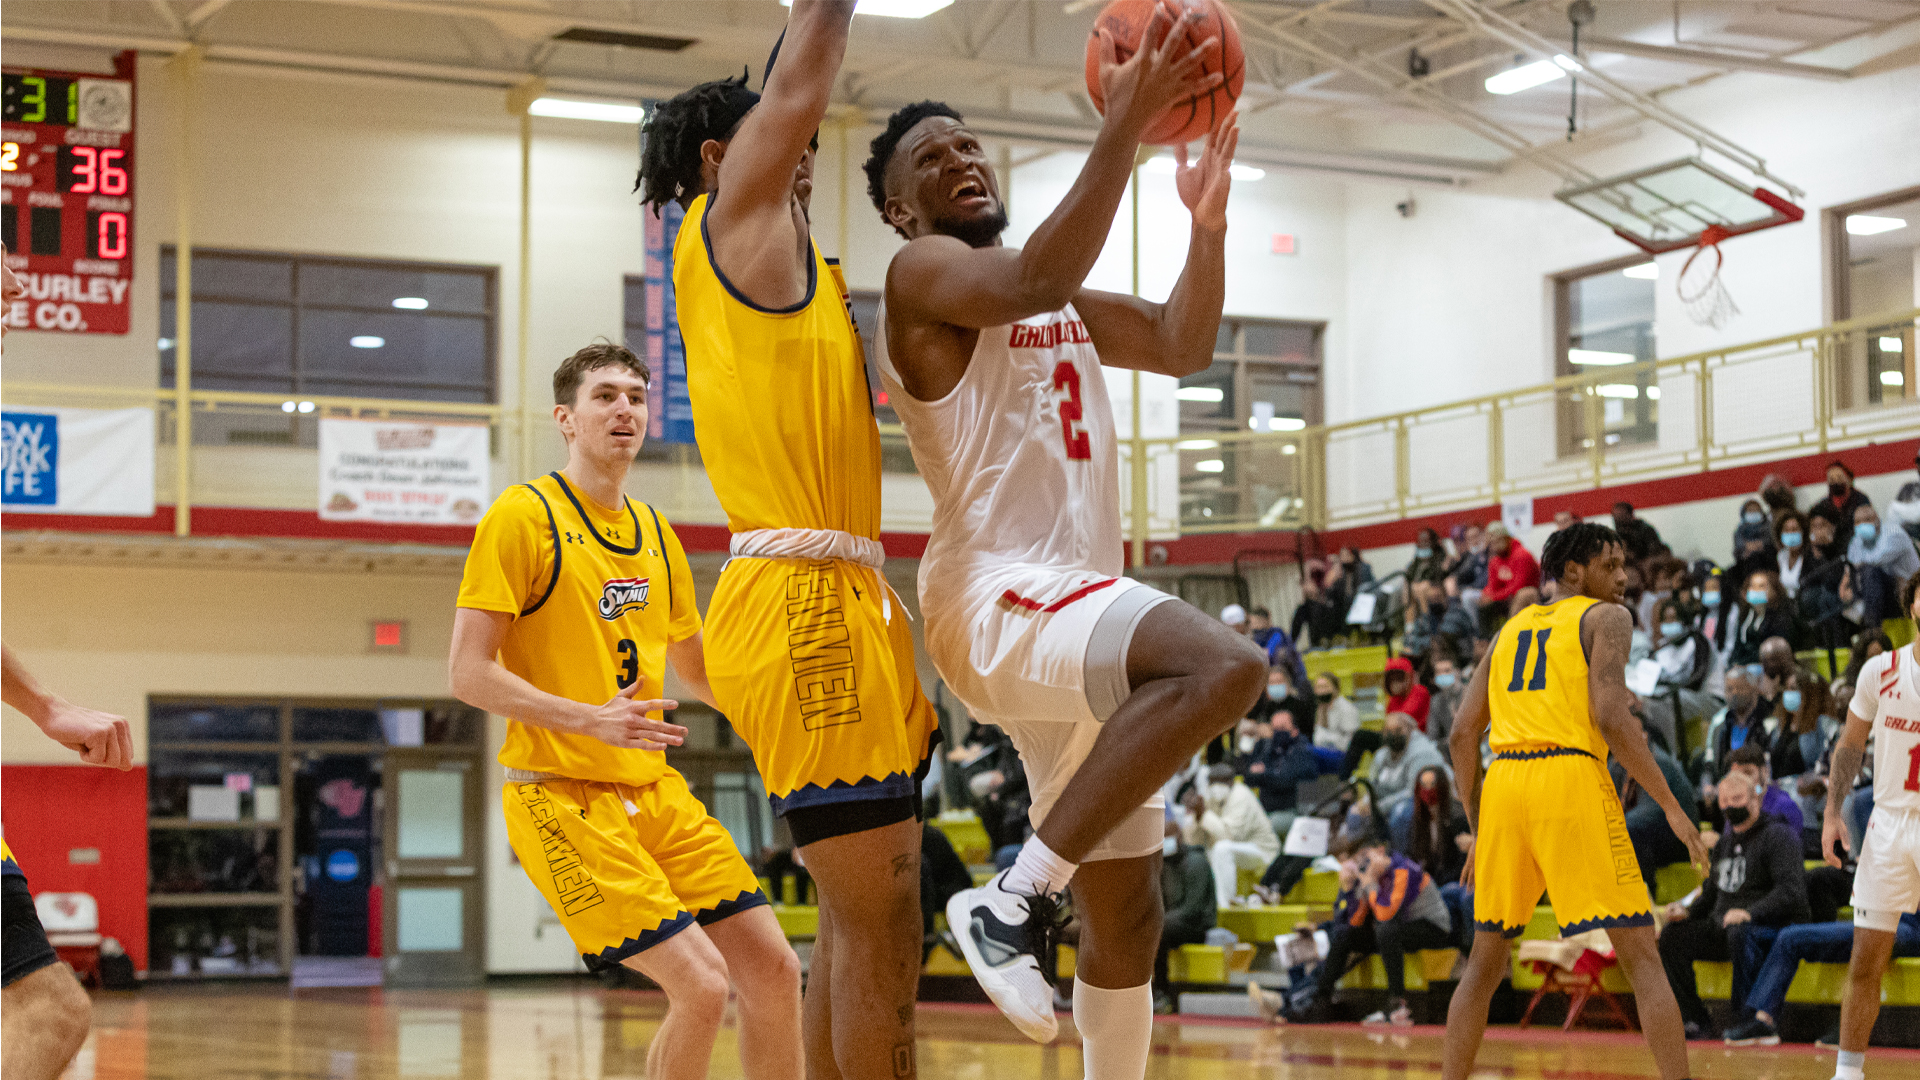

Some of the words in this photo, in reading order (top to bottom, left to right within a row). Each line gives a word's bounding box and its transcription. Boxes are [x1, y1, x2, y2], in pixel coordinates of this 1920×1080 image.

[1, 142, 20, 171] 2
[70, 146, 127, 195] 36
[98, 212, 127, 259] 0
[36, 302, 88, 331] CO.
[1053, 360, 1092, 462] 2
[616, 638, 639, 690] 3
[786, 559, 862, 732] ENMEN
[1507, 627, 1553, 692] 11
[1884, 715, 1920, 734] CALD
